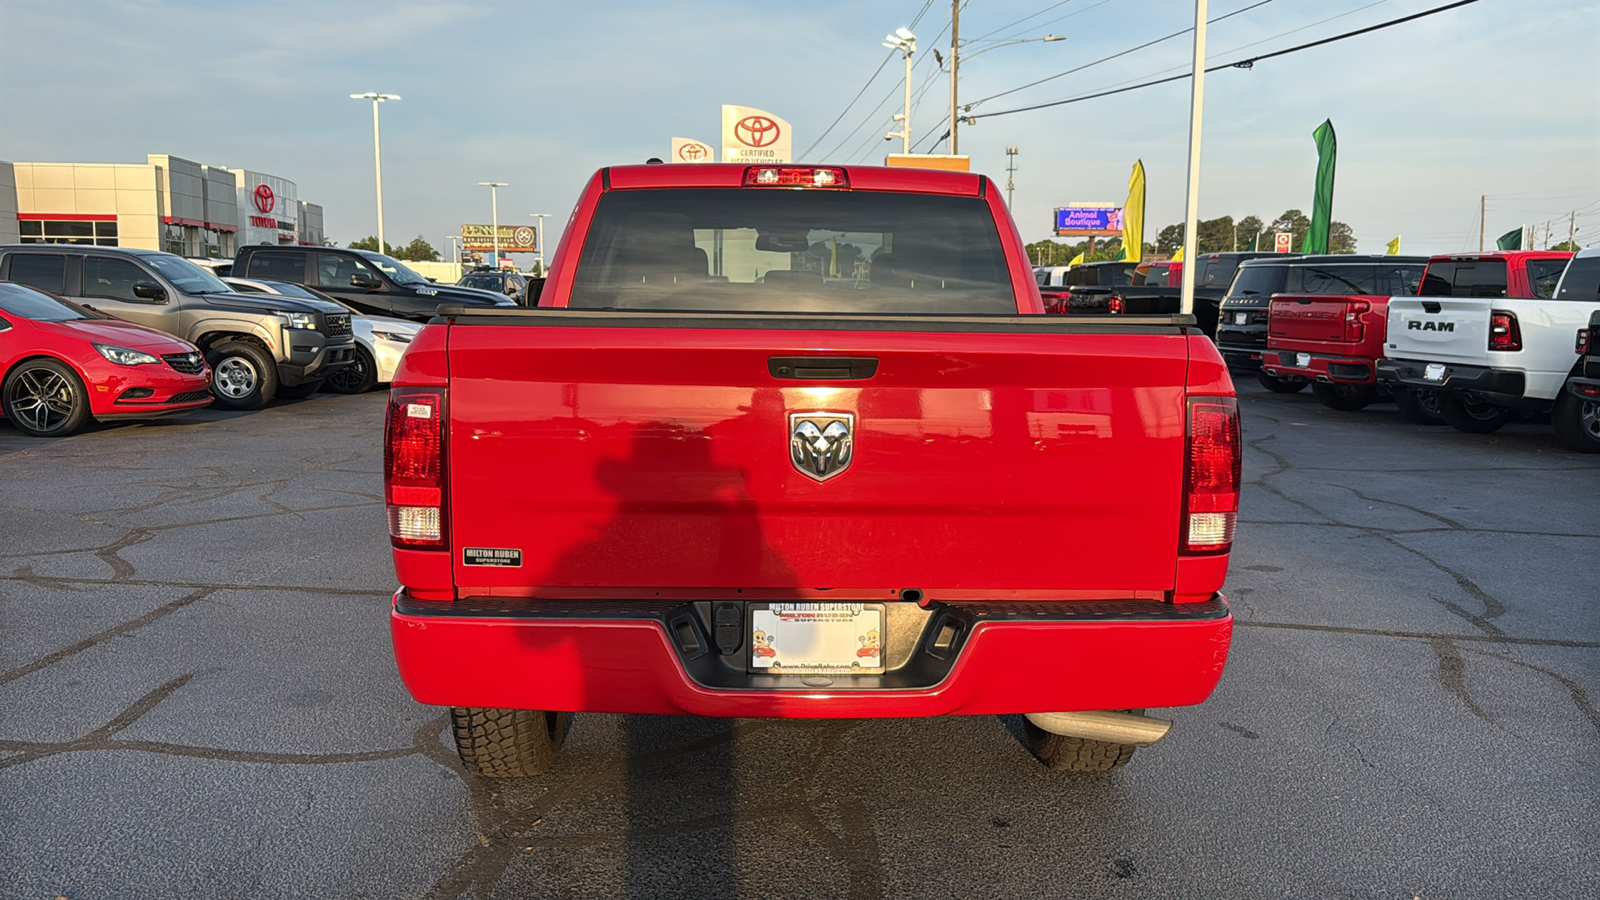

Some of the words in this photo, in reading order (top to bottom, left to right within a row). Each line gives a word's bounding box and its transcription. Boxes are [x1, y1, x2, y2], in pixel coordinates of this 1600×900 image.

[740, 149, 775, 157] CERTIFIED
[1069, 211, 1098, 219] Animal
[250, 215, 277, 229] TOYOTA
[1064, 217, 1101, 227] Boutique
[1272, 310, 1338, 319] CHEVROLET
[1408, 320, 1455, 333] RAM
[466, 549, 493, 557] MILTON
[494, 550, 519, 558] RUBEN
[768, 603, 795, 611] MILTON
[796, 603, 819, 611] RUBEN
[820, 603, 865, 611] SUPERSTORE
